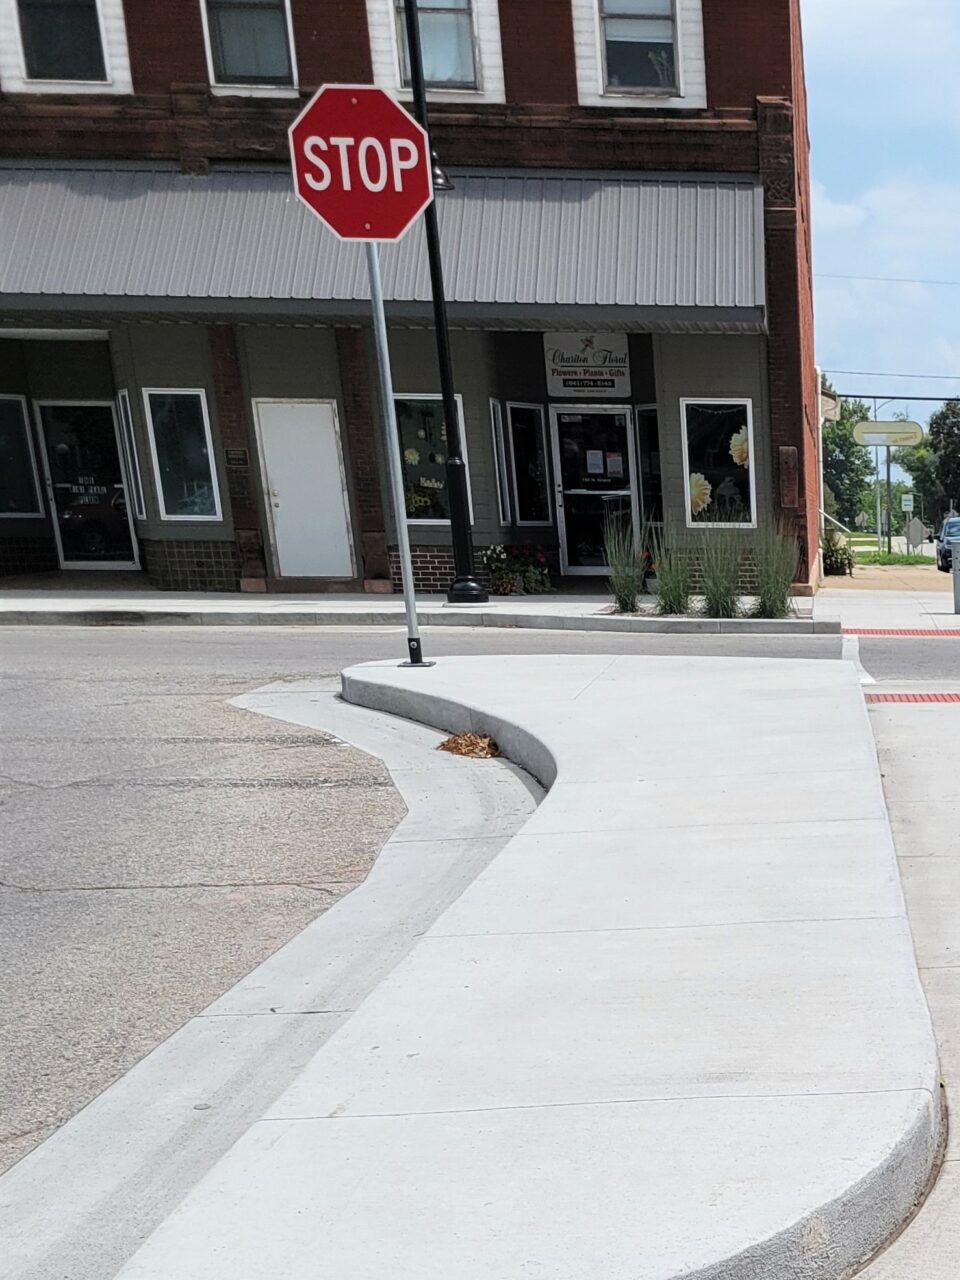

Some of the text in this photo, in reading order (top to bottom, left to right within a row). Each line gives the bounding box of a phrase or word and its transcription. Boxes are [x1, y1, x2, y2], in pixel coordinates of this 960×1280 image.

[303, 135, 419, 193] STOP
[593, 349, 627, 366] Floral
[551, 368, 625, 377] Flowers Plants Gifts
